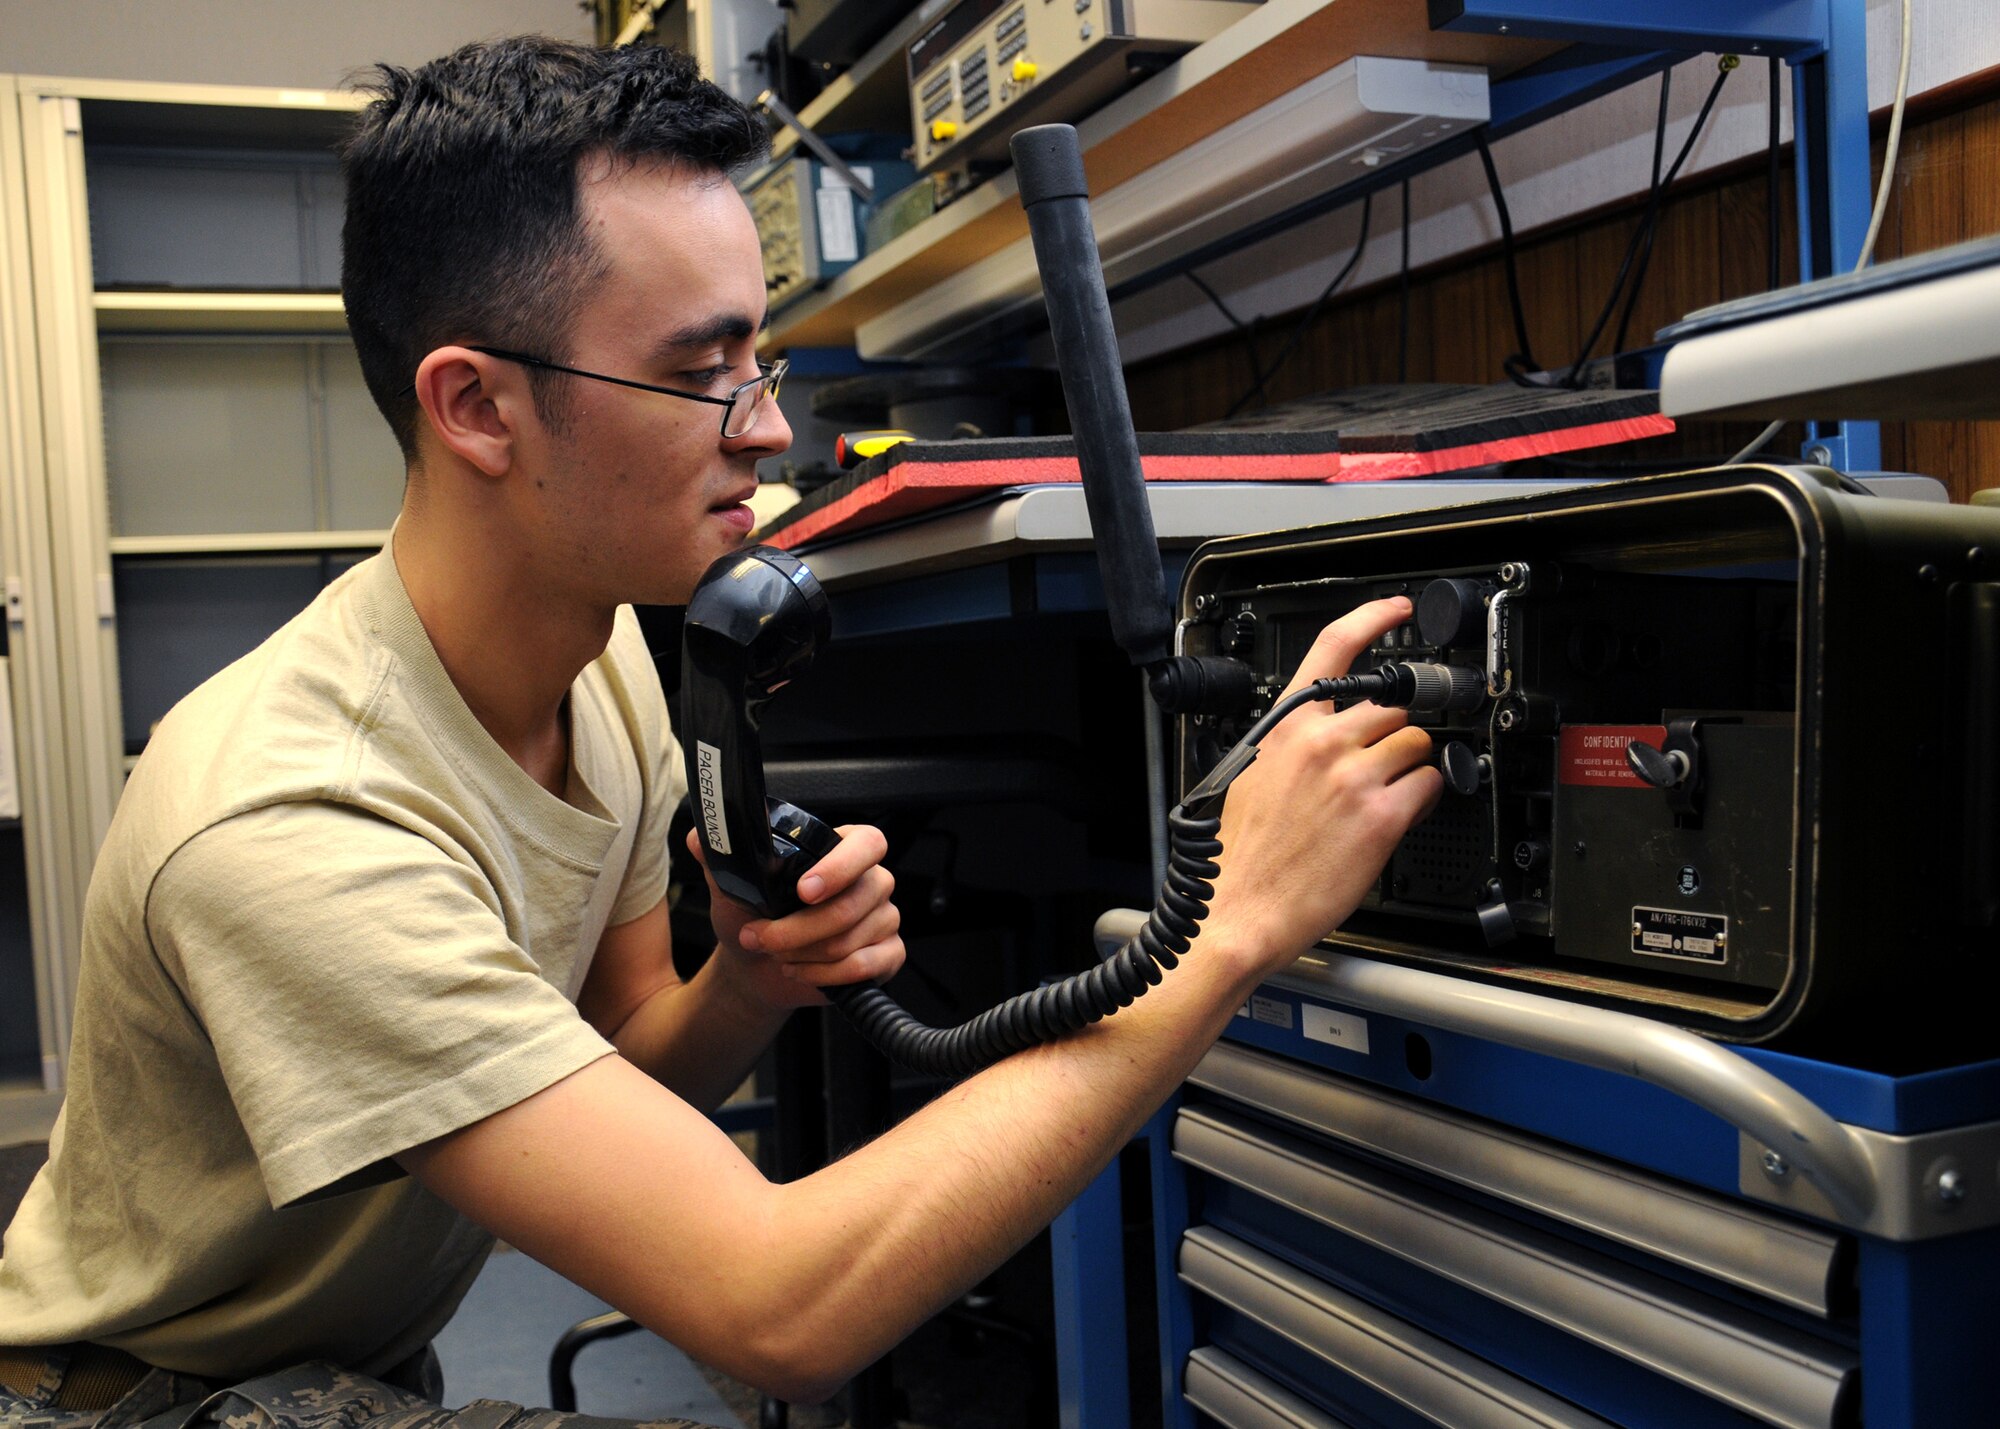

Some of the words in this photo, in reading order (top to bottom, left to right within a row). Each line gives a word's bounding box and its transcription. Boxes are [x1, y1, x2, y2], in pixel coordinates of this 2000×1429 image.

[1241, 602, 1252, 611] DIM
[1602, 758, 1614, 766] WHEN
[699, 748, 714, 797] PACER
[1585, 769, 1607, 777] MATERIALS
[1608, 770, 1616, 778] ARE
[703, 798, 723, 850] BOUNCE
